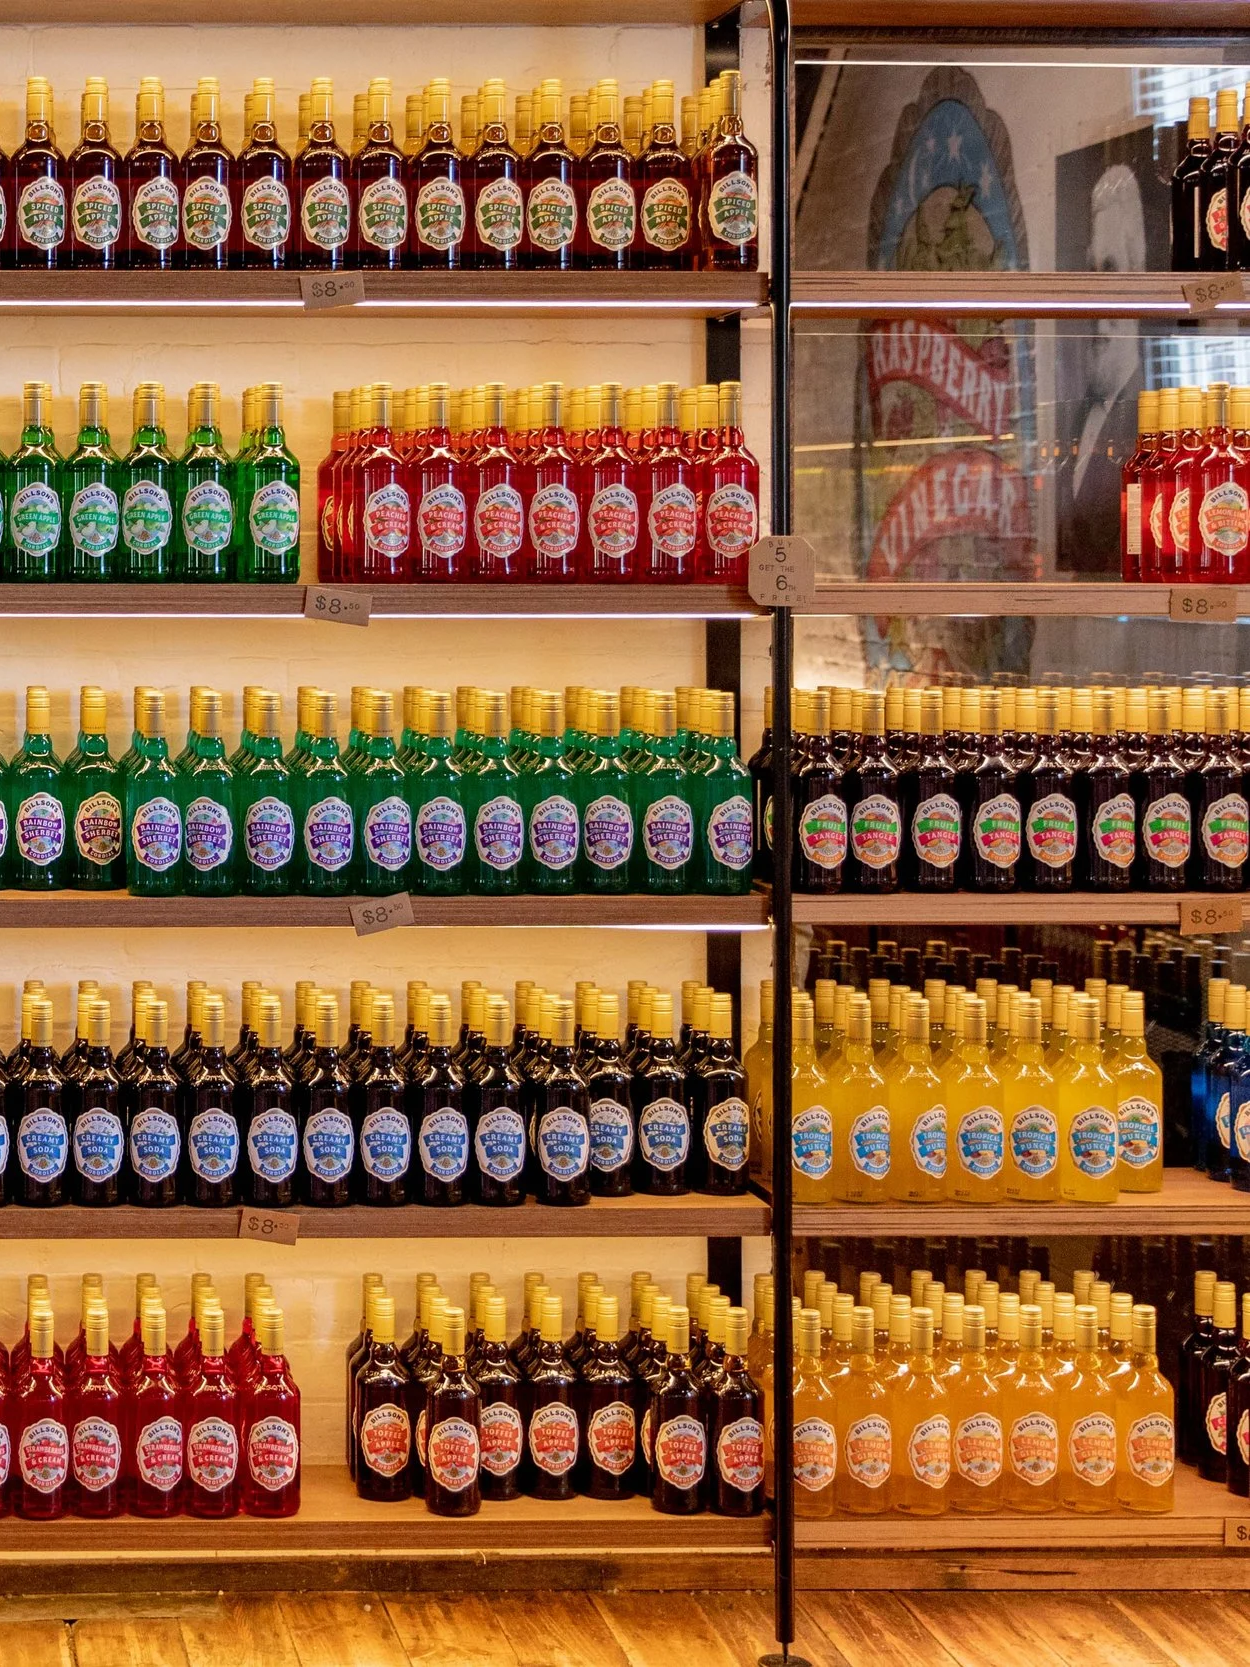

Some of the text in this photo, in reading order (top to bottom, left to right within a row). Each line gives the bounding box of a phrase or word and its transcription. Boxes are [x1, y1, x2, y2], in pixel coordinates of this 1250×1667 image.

[873, 319, 1008, 435] RASPBERRY
[19, 491, 55, 504] BILLSON'S
[427, 492, 461, 505] BILLSON'S
[1211, 490, 1245, 503] BILLSON'S
[17, 512, 57, 522] GREEN APPLE
[429, 511, 461, 520] PEACHES
[880, 462, 1014, 573] VINEGAR
[431, 522, 460, 531] & CREAM
[23, 540, 52, 550] CORDIAL
[432, 543, 457, 552] CORDIAL
[775, 547, 786, 562] 5
[1037, 801, 1072, 814] BILLSON'S
[1044, 818, 1070, 827] FRUIT
[1041, 830, 1070, 839] TANGLE
[26, 1116, 61, 1129] BILLSON'S
[1017, 1113, 1052, 1126] BILLSON'S
[26, 1135, 60, 1144] CREAMY
[1018, 1131, 1052, 1141] TROPICAL
[33, 1146, 53, 1154] SODA
[1020, 1144, 1050, 1152] PUNCH
[30, 1166, 57, 1176] CORDIAL
[1022, 1162, 1050, 1173] CORDIAL
[1018, 1420, 1053, 1433] BILLSON'S
[437, 1426, 472, 1438] BILLSON'S
[1021, 1438, 1052, 1448] LEMON
[440, 1444, 469, 1453] TOFFEE
[441, 1455, 468, 1463] APPLE
[1021, 1450, 1052, 1459] GINGER
[440, 1476, 468, 1487] CORDIAL
